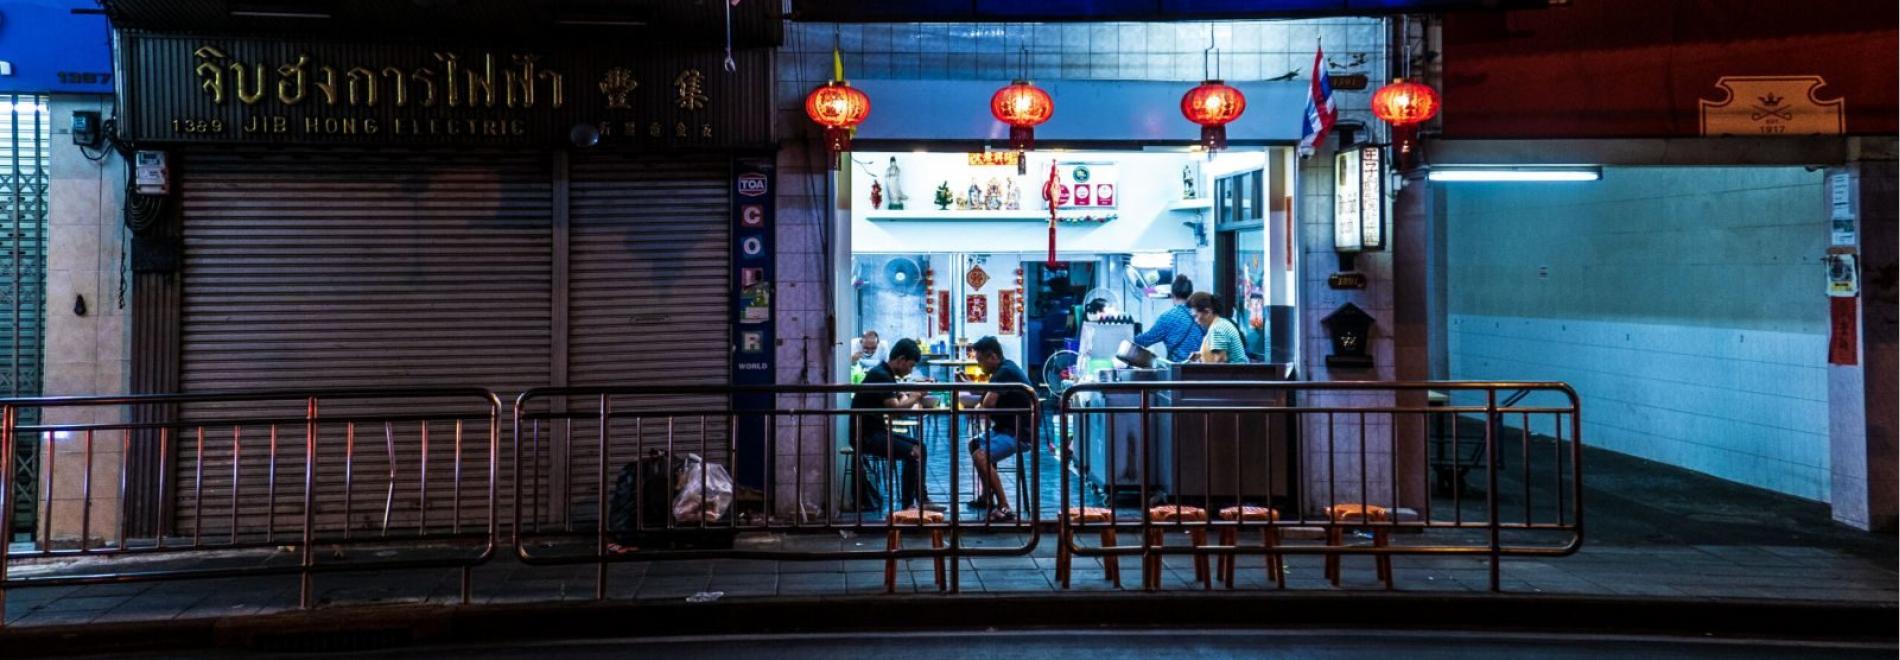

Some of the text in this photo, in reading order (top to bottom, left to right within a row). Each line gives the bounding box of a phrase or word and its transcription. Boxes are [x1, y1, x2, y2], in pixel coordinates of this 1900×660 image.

[57, 71, 111, 84] 1387
[171, 115, 526, 136] 1389 JIB HONG ELECTRIC
[1759, 125, 1786, 134] 1917
[740, 179, 765, 190] TOA
[738, 362, 768, 370] WORLD
